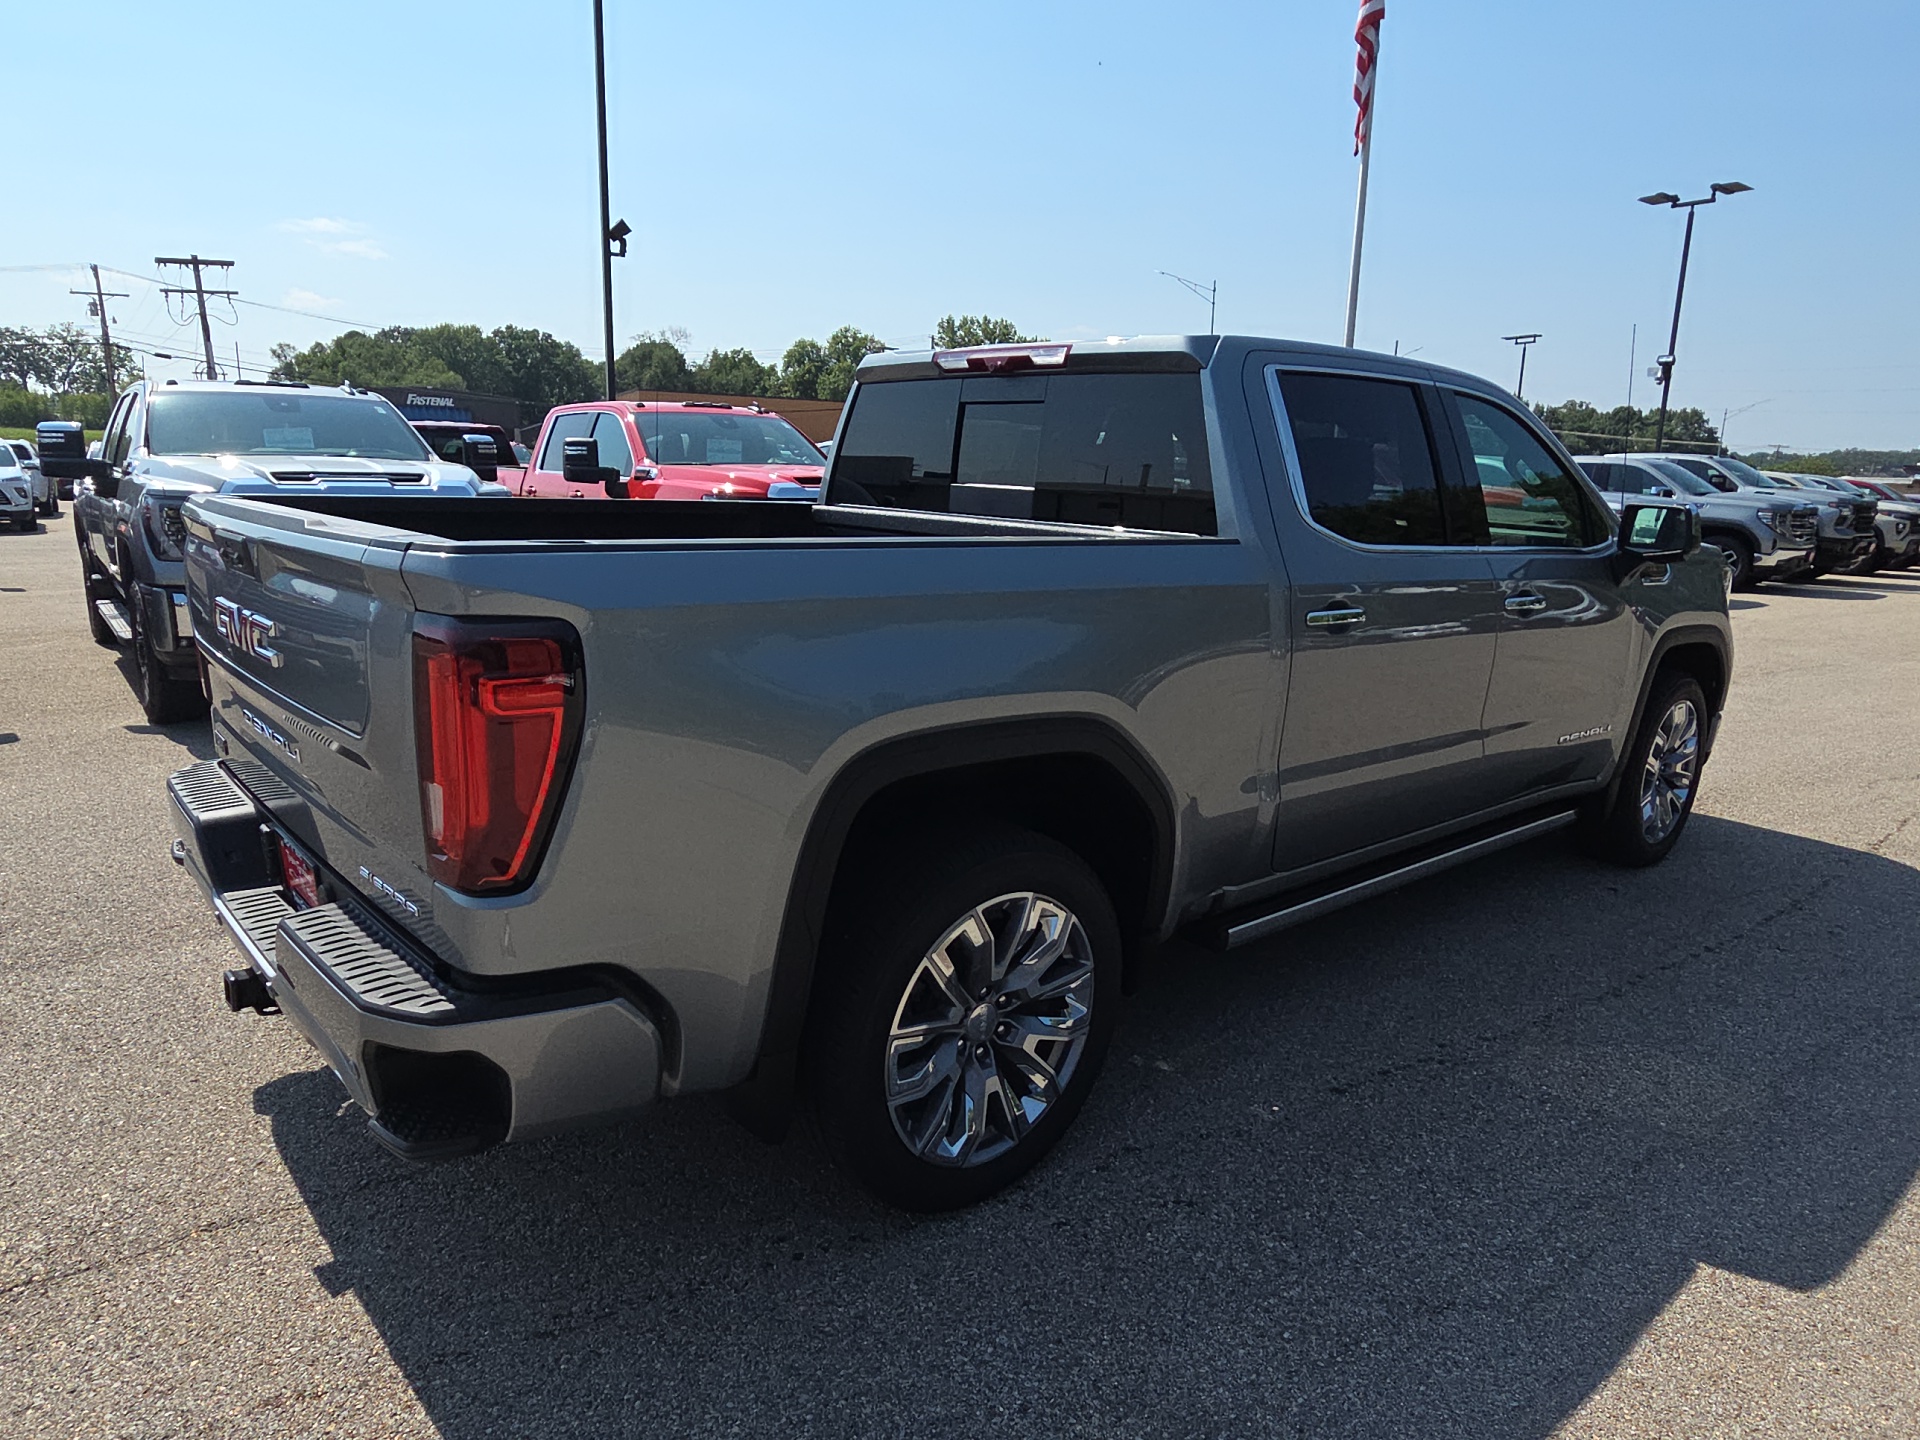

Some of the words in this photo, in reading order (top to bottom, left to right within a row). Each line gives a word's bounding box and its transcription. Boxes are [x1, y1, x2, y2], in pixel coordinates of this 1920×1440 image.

[406, 393, 455, 407] FASTENAL
[213, 596, 284, 668] GMC
[242, 709, 302, 763] DENALI
[1558, 724, 1612, 744] DENALI
[359, 865, 421, 917] SIERRA
